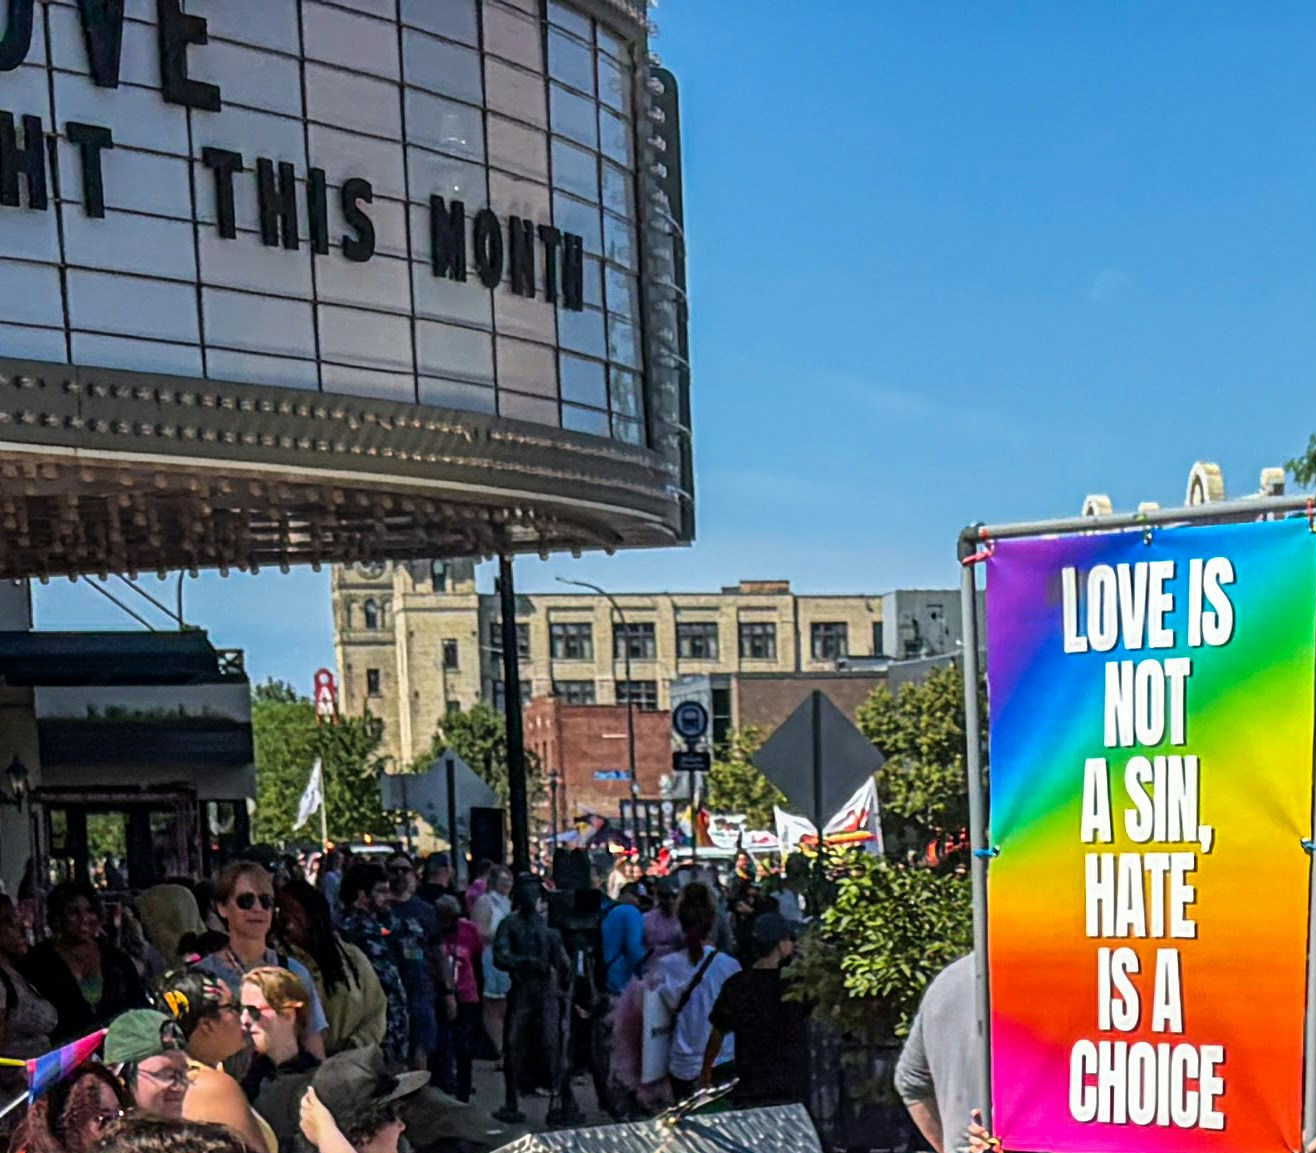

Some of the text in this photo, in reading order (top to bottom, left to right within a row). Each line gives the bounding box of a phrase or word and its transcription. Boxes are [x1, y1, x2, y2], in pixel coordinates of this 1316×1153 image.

[201, 146, 375, 263] THIS
[430, 194, 583, 312] MONTH
[1062, 556, 1235, 653] LOVE IS
[1104, 657, 1191, 747] NOT
[1081, 755, 1214, 853] A SIN,
[1085, 851, 1197, 938] HATE
[1097, 947, 1183, 1033] IS A
[1069, 1039, 1225, 1131] CHOICE
